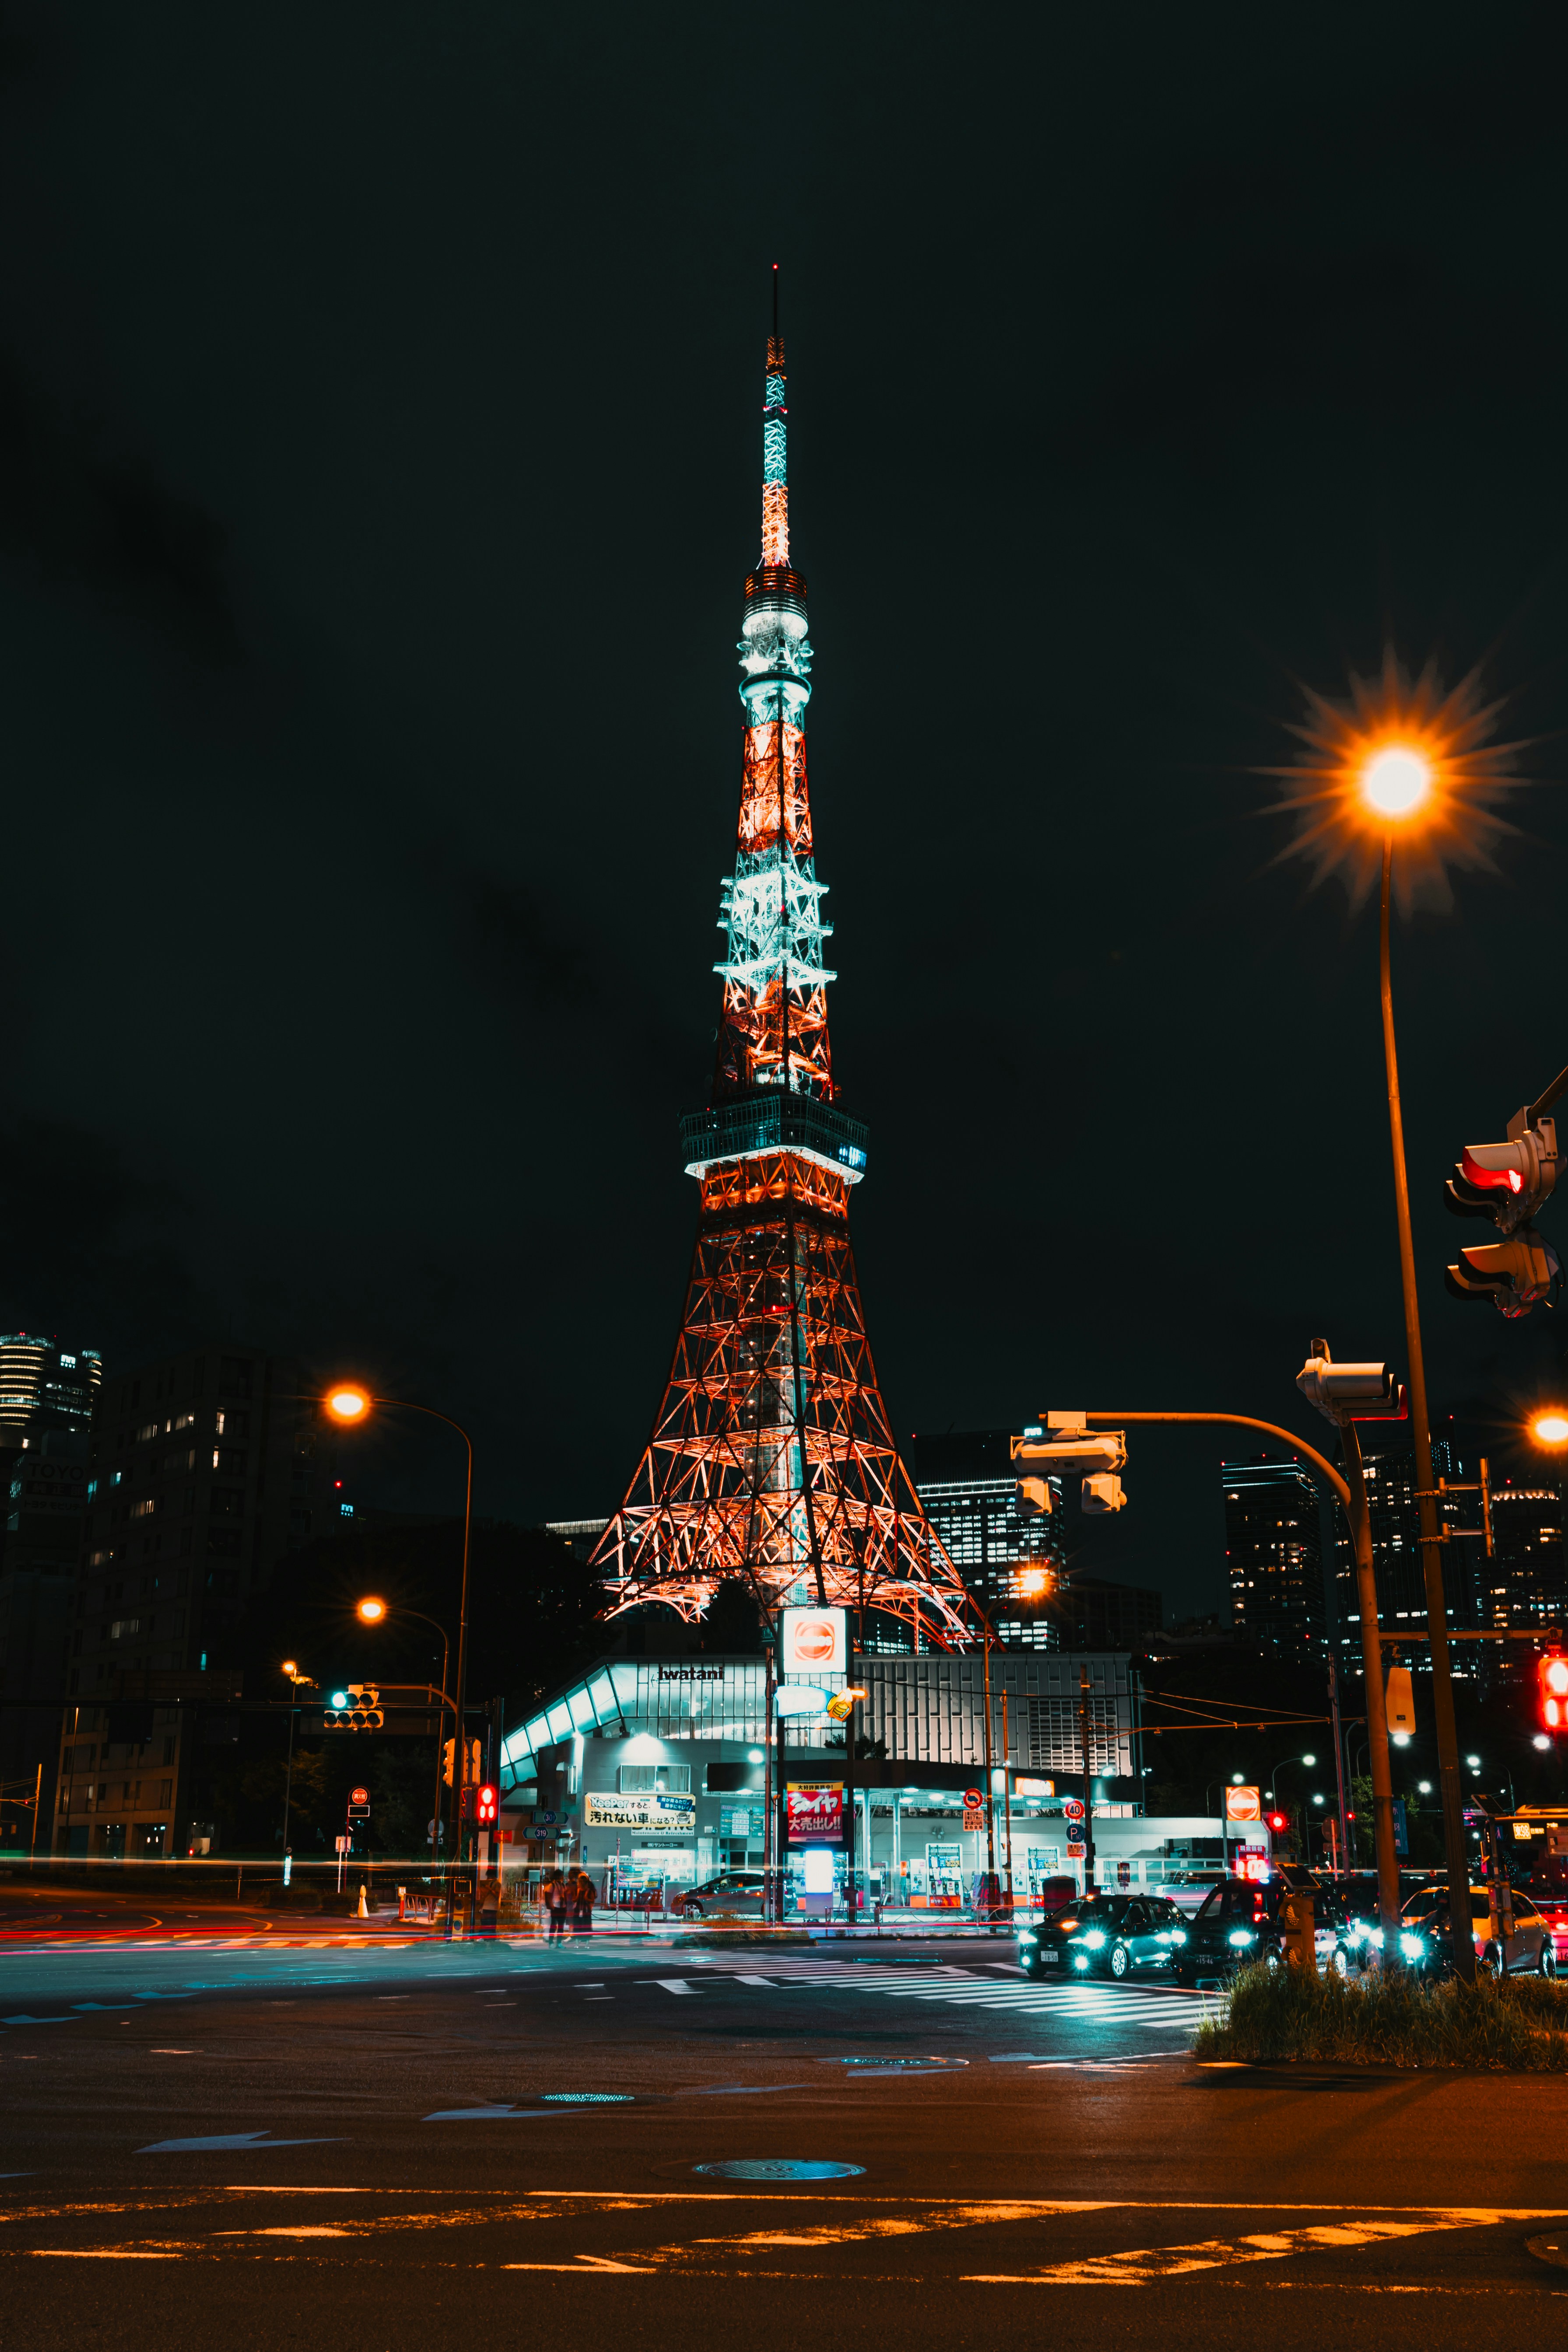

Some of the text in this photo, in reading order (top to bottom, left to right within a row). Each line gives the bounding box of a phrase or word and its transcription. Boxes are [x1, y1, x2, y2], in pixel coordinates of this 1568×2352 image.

[28, 1462, 86, 1481] TOYO
[659, 1666, 723, 1680] Iwatani
[591, 1797, 629, 1808] KeePer
[790, 1795, 838, 1814] タイヤ
[1070, 1805, 1080, 1814] 40
[1070, 1827, 1077, 1840] P
